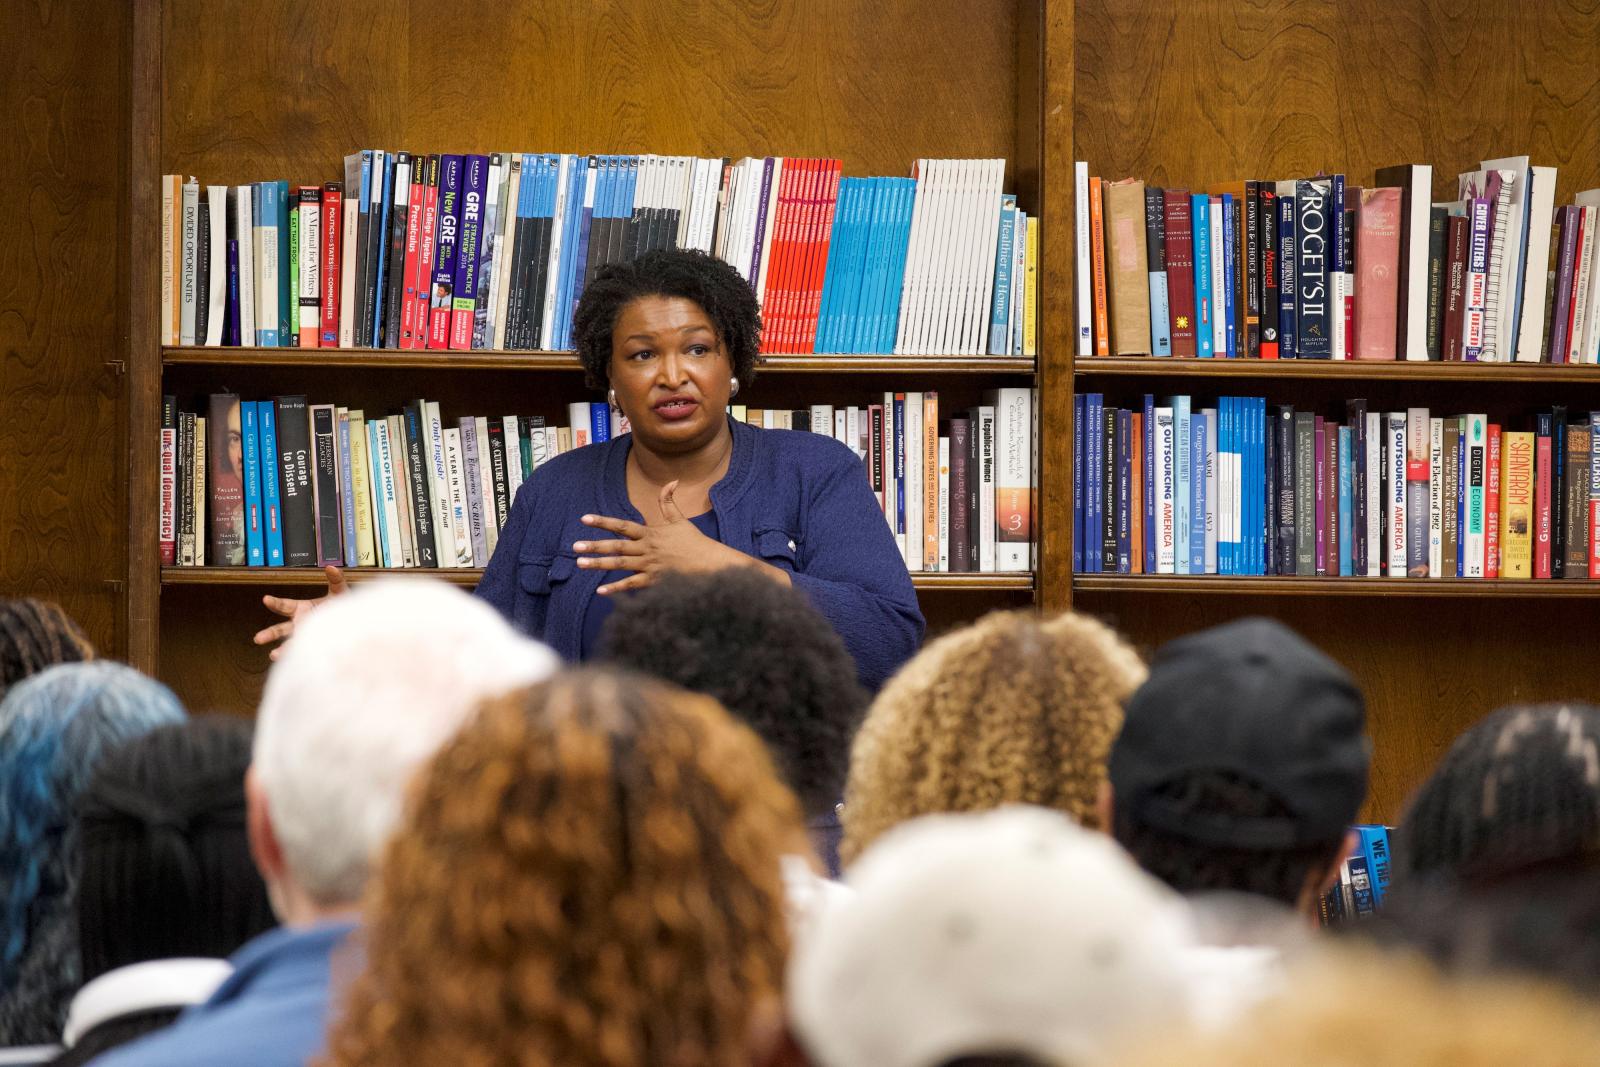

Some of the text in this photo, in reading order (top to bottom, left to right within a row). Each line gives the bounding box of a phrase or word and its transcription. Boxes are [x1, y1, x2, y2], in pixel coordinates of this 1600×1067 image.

[415, 157, 423, 184] SCHAUM'S
[464, 160, 480, 221] KAPLAN GRE
[328, 207, 336, 234] POLITICS
[423, 207, 435, 233] College
[444, 191, 456, 214] New
[1146, 196, 1156, 230] BEAT
[1156, 196, 1165, 239] DEATH
[408, 205, 420, 252] Precalculus
[421, 235, 432, 264] Algebra
[441, 215, 456, 246] GRE
[460, 229, 471, 269] REVIEW 2014
[998, 219, 1012, 280] Healthier at
[1247, 201, 1257, 274] POWER CHOICE
[1263, 213, 1277, 288] Publication Manual
[1473, 204, 1488, 268] COVER LETTERS
[185, 206, 195, 303] DIVIDED OPPORTUNITIES
[307, 218, 318, 296] Manual for Writers
[465, 224, 478, 294] STRATEGIES, PRACTICE
[1199, 227, 1208, 290] GLOBAL JOURNALISM
[1284, 237, 1294, 294] GLOBAL JOURNALISM
[1301, 196, 1325, 316] ROGET'S II
[1450, 262, 1458, 289] Technical
[1455, 262, 1463, 290] Handbook
[380, 424, 390, 461] STREETS
[412, 442, 419, 454] we
[432, 417, 445, 480] ¿Only English?
[981, 418, 993, 483] Republican Women
[1015, 396, 1025, 472] Qualitative Research
[1180, 418, 1189, 482] AMERICAN GOVERNMENT
[184, 457, 193, 497] Square Dancing
[247, 434, 257, 497] GLOBAL JOURNALISM
[265, 434, 275, 498] GLOBAL JOURNALISM
[283, 452, 297, 497] to Dissent
[296, 449, 308, 486] Courage
[344, 466, 352, 496] TROUBLE
[383, 462, 391, 474] OF
[411, 454, 422, 473] gotta
[413, 473, 422, 483] get
[450, 454, 461, 504] YEAR IN THE
[493, 449, 504, 493] CULTURE OF
[1008, 443, 1017, 475] Methods
[1194, 425, 1205, 520] Congress Reconsidered
[1508, 442, 1531, 505] SHANTARAM
[351, 440, 366, 531] Slavery Arab World
[385, 476, 394, 502] HOPE
[416, 483, 424, 495] out
[467, 457, 481, 537] Eloquence SCRIBES
[953, 459, 965, 530] Silver Sparrow
[1163, 429, 1172, 548] OUTSOURCING AMERICA
[1394, 433, 1403, 551] OUTSOURCING AMERICA
[1432, 447, 1441, 530] The Election of 1992
[1472, 449, 1482, 531] DIGITAL ECONOMY
[1487, 437, 1499, 571] RISE REST STEVE CASE
[416, 518, 429, 535] place
[418, 503, 427, 518] this
[1009, 513, 1022, 531] 3
[1415, 483, 1423, 561] RUDOLPH GIULIANI
[1371, 839, 1386, 860] WE
